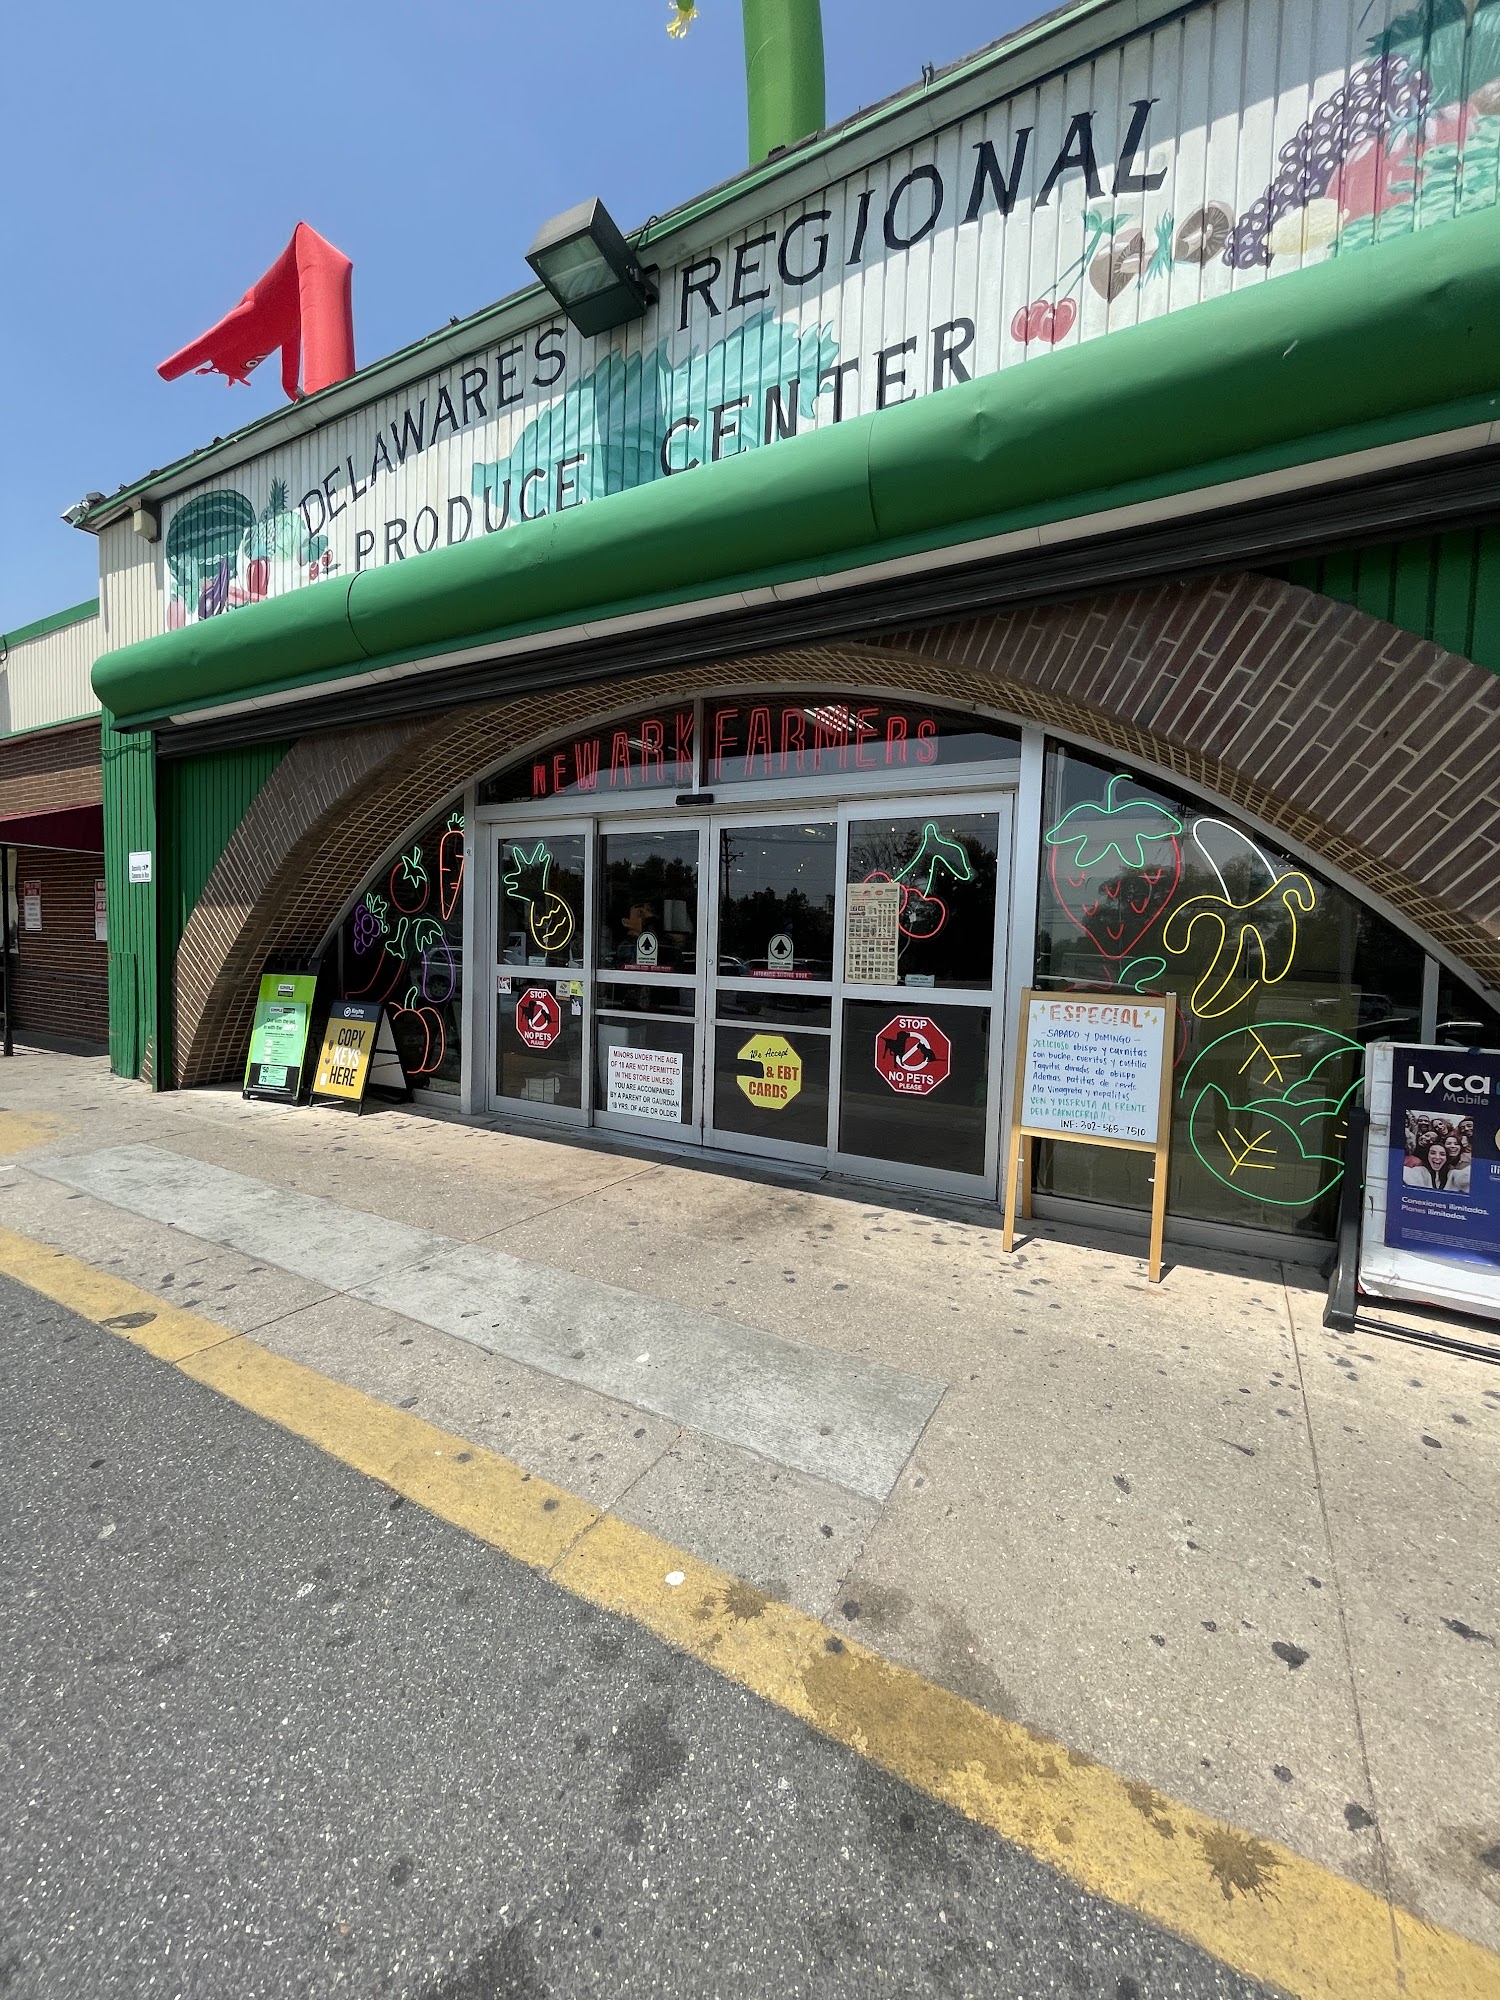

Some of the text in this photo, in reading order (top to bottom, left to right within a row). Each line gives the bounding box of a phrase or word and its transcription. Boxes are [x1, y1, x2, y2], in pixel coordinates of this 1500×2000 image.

[298, 98, 1168, 538] DELAWARES REGIONAL
[355, 317, 976, 571] PRODUCE CENTER
[533, 704, 936, 796] NEWARK FARMERS
[529, 990, 548, 999] STOP
[898, 1018, 928, 1030] STOP
[1050, 1004, 1143, 1028] ESPECIAL
[337, 1027, 365, 1048] COPY
[524, 1031, 552, 1042] NO PETS
[750, 1048, 789, 1060] We Accept
[1032, 1038, 1070, 1050] DELICIOSO
[1074, 1043, 1098, 1054] obispo
[1110, 1046, 1148, 1058] carnitas
[332, 1046, 361, 1069] KEYS
[614, 1050, 634, 1059] MINORS
[634, 1053, 653, 1061] UNDER
[666, 1056, 678, 1064] AGE
[1076, 1055, 1107, 1066] cueritos
[610, 1060, 618, 1068] OF
[626, 1062, 636, 1070] ARE
[650, 1066, 680, 1076] PERMITTED
[766, 1065, 800, 1082] & EBT
[1032, 1060, 1060, 1072] Taquitos
[1064, 1064, 1090, 1074] dorados
[1095, 1067, 1104, 1076] de
[329, 1066, 358, 1087] HERE
[622, 1072, 632, 1080] THE
[632, 1074, 650, 1082] STORE
[652, 1076, 674, 1086] UNLESS:
[888, 1071, 934, 1085] NO PETS
[1032, 1072, 1061, 1082] Ademas
[1066, 1075, 1095, 1086] patitas
[1100, 1079, 1110, 1088] de
[1407, 1065, 1491, 1095] Lyca
[637, 1085, 675, 1096] ACCOMPANIED
[748, 1081, 788, 1100] CARDS
[898, 1082, 923, 1092] PLEASE
[622, 1093, 642, 1102] PARENT
[1093, 1090, 1130, 1102] nopalitos
[1442, 1092, 1490, 1106] Mobile
[638, 1106, 649, 1114] AGE
[660, 1109, 678, 1118] OLDER
[1030, 1096, 1046, 1104] VEN
[1058, 1098, 1097, 1110] DISFRUTA
[1102, 1101, 1110, 1111] AL
[1114, 1102, 1146, 1113] FRENTE
[1401, 1204, 1426, 1214] Planes
[1402, 1196, 1490, 1216] Conexiones ilimitadas.
